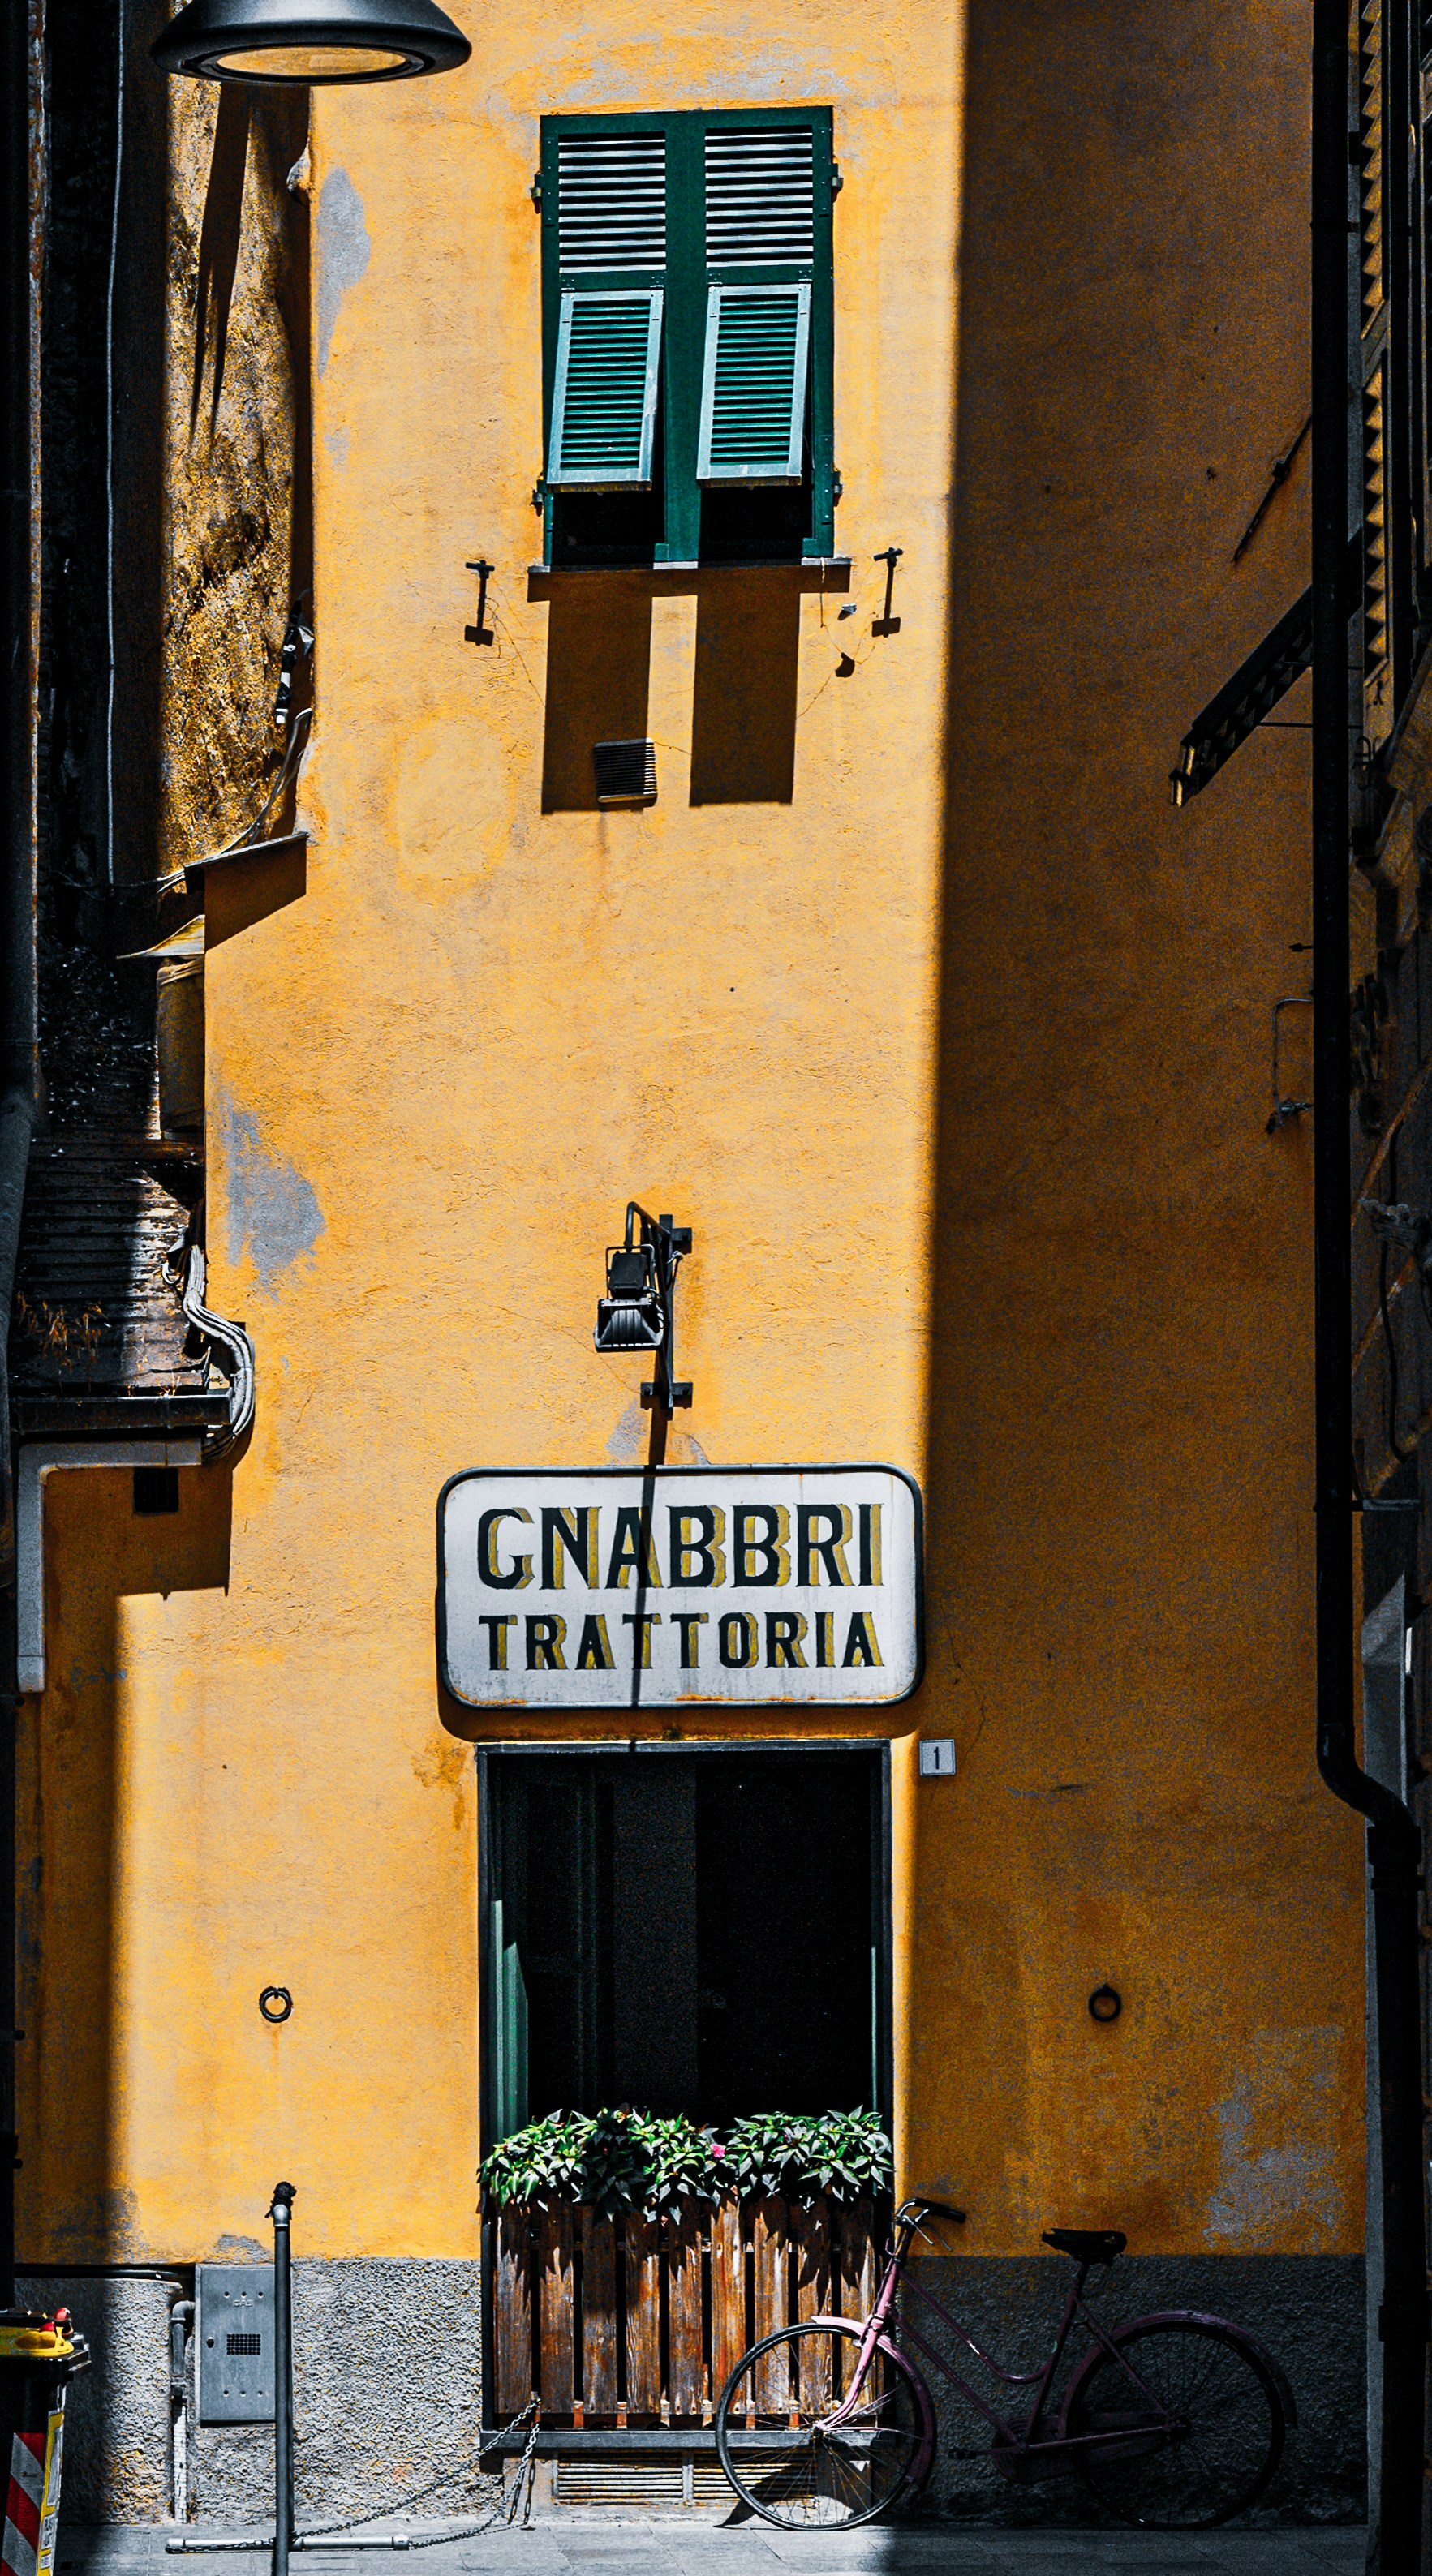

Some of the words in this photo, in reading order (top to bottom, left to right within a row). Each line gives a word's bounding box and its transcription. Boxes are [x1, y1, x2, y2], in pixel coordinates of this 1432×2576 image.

[477, 1503, 885, 1590] GNABBRI
[478, 1611, 885, 1671] TRATTORIA
[933, 1745, 940, 1771] 1
